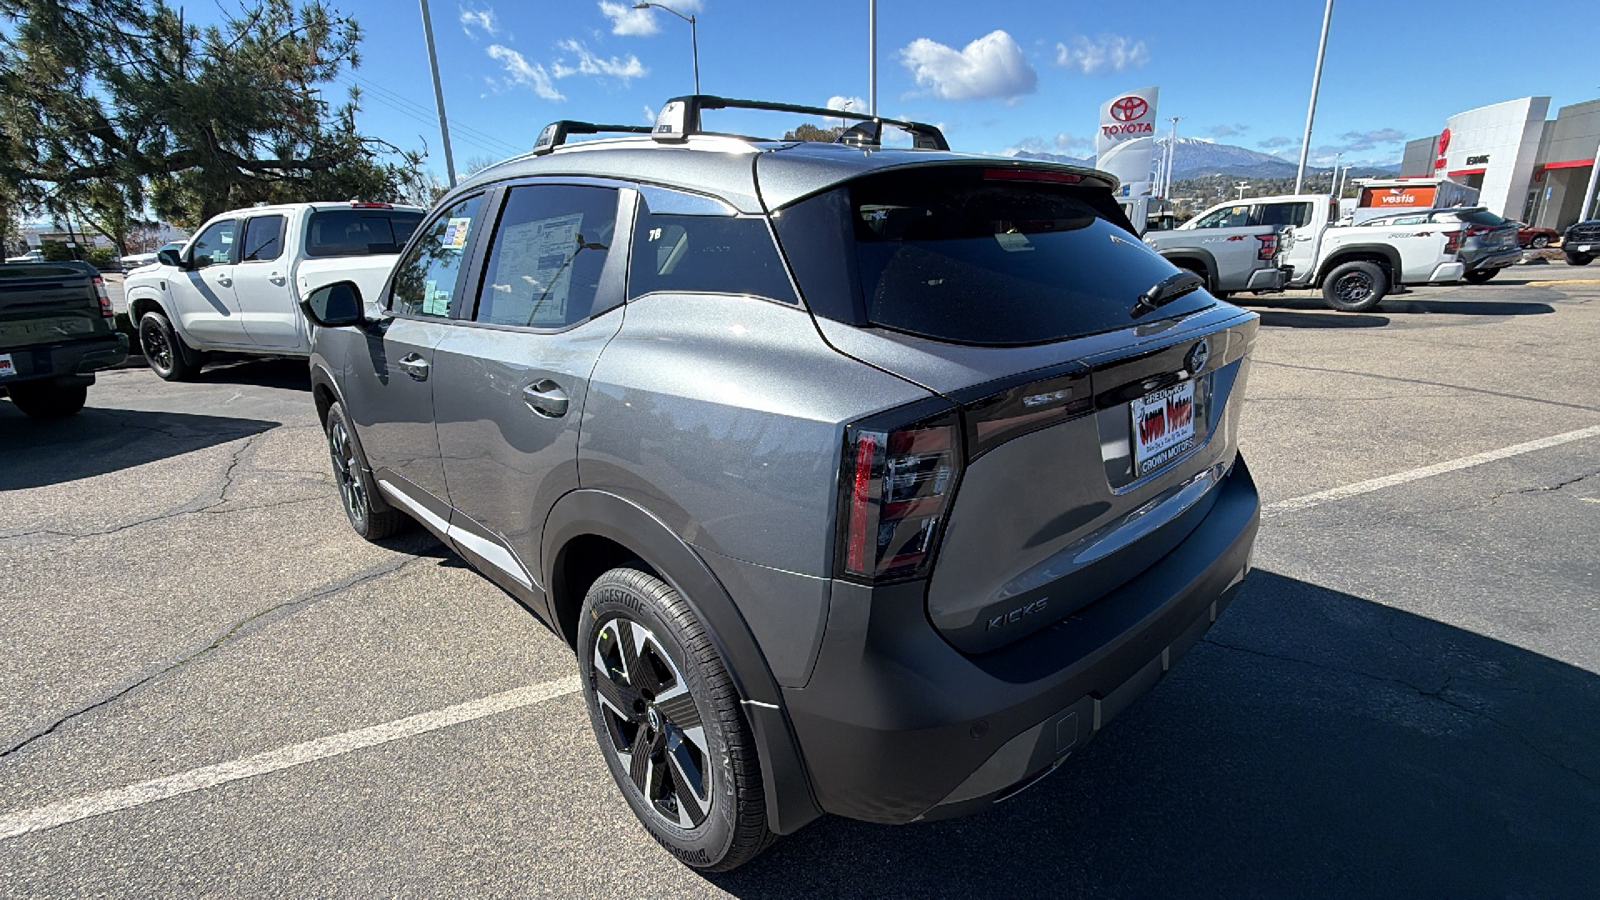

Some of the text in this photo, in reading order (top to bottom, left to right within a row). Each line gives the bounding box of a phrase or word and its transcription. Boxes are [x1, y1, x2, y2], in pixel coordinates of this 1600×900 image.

[1101, 122, 1152, 136] TOYOTA
[1382, 194, 1415, 204] vestis
[648, 227, 662, 242] 78
[1142, 450, 1168, 473] CROWN
[1167, 438, 1194, 459] MOTORS
[985, 597, 1049, 631] KICKS
